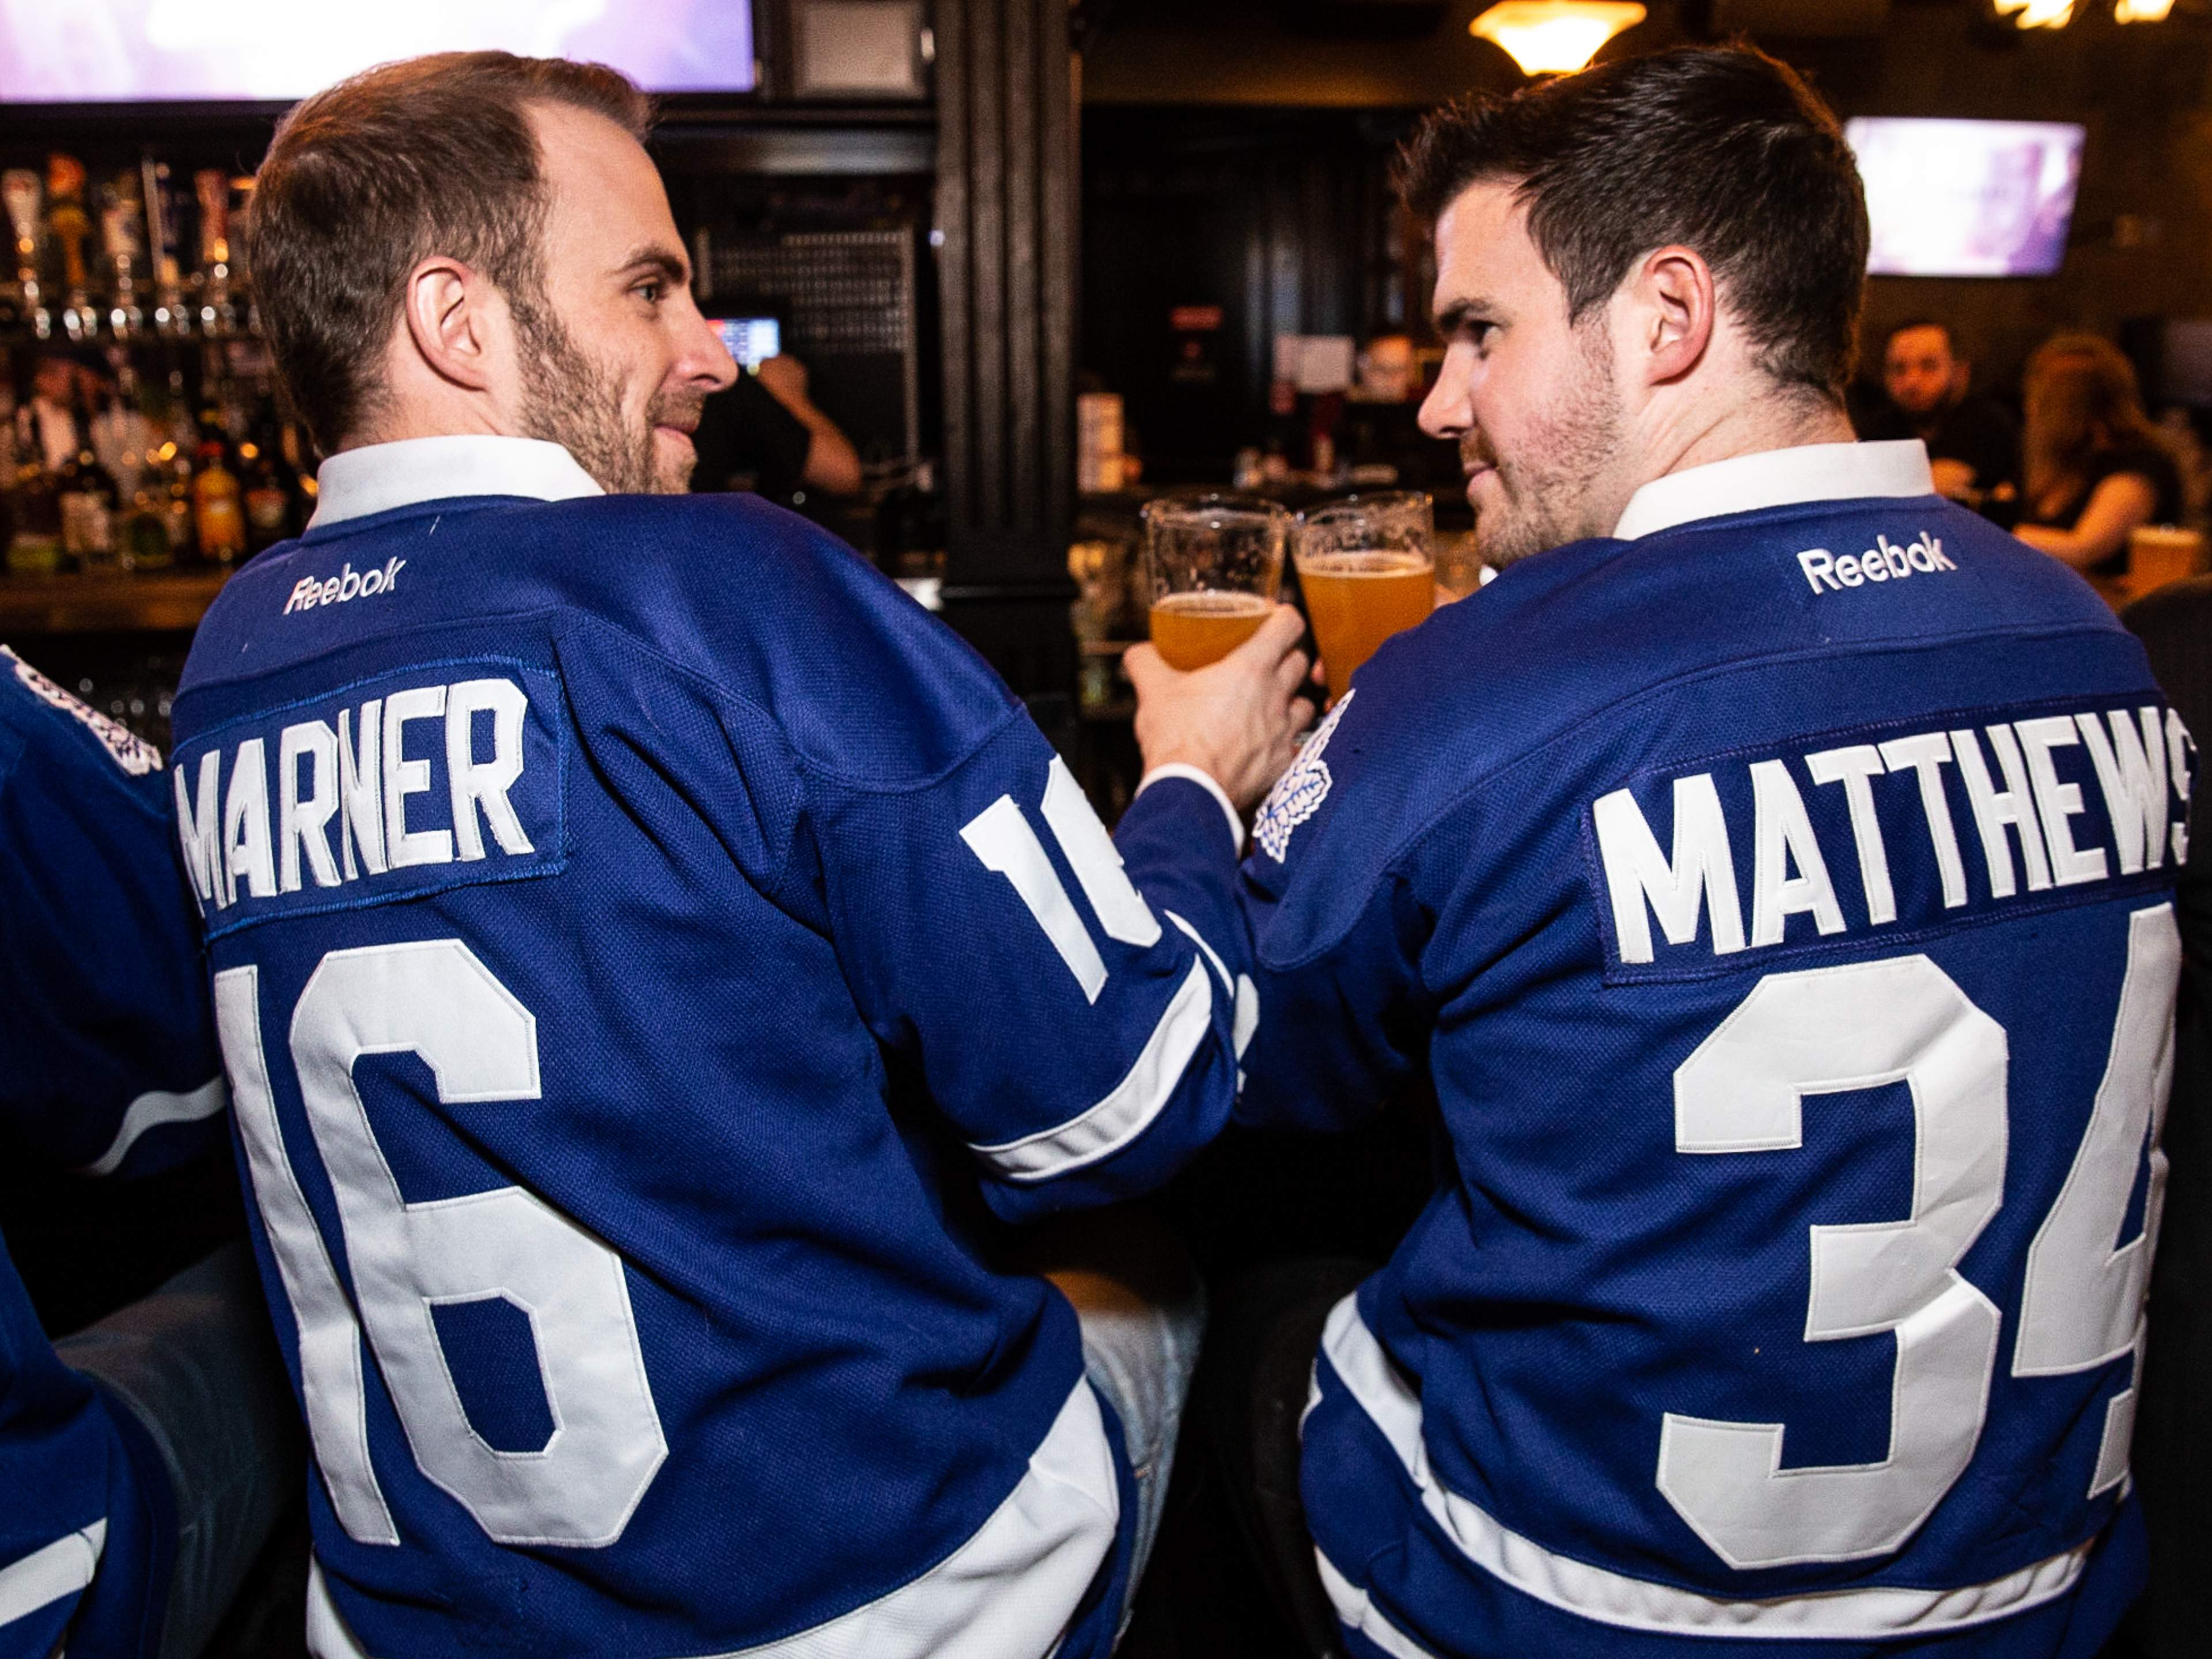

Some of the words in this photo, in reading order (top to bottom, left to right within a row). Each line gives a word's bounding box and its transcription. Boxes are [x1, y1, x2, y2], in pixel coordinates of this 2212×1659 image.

[283, 555, 407, 615] Reebok
[1796, 530, 1959, 595] Reebok
[174, 678, 535, 919] MARNER
[214, 938, 669, 1548] 16
[1656, 902, 2183, 1570] 34
